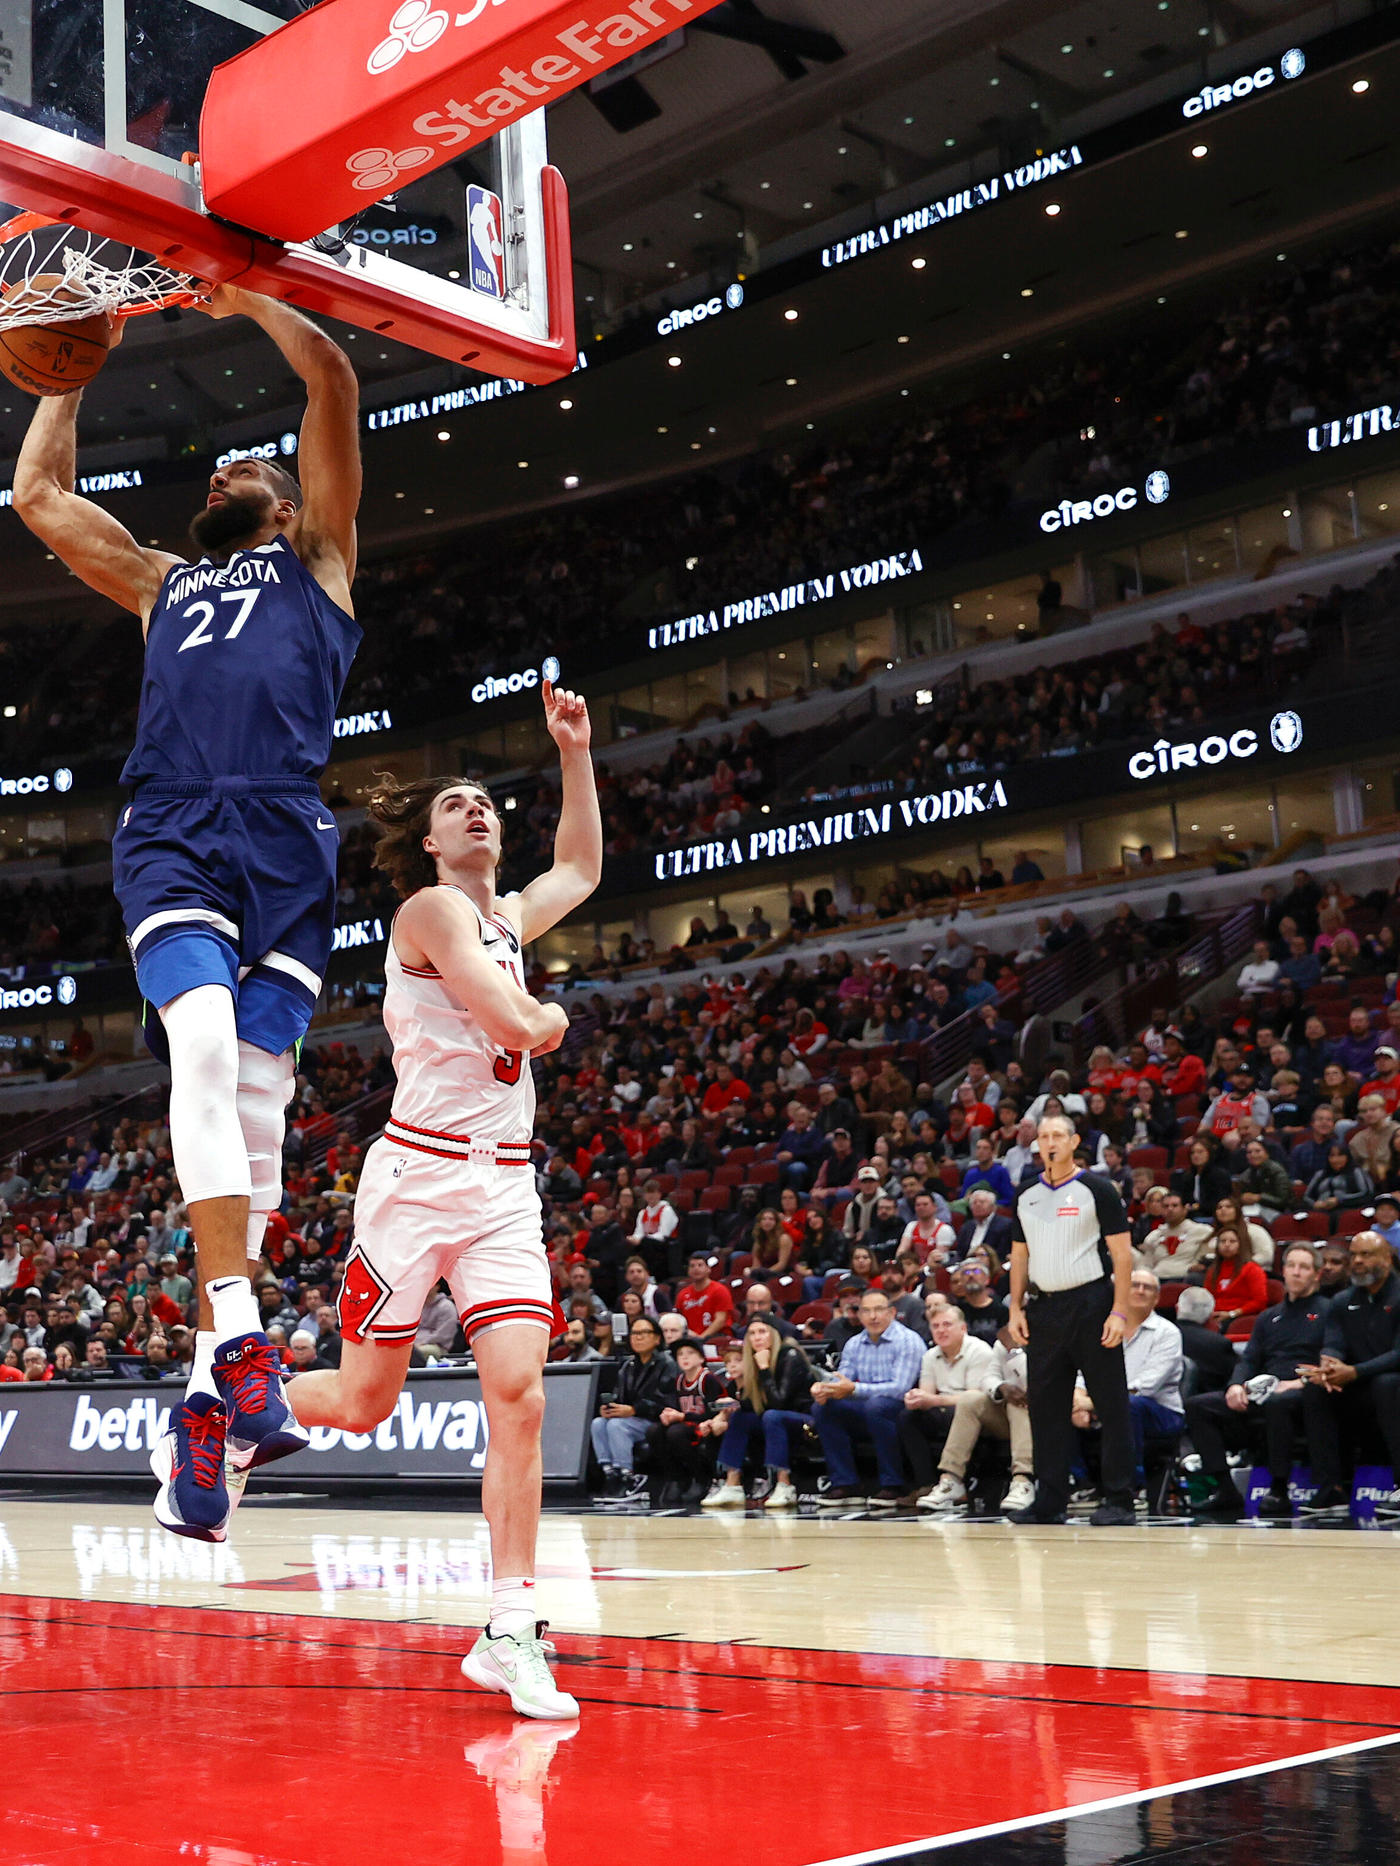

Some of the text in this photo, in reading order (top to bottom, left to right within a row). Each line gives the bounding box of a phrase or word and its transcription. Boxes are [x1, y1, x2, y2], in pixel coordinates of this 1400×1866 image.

[412, 0, 693, 147] StateFar
[1182, 66, 1276, 118] CÎROC
[821, 145, 1083, 268] ULTRA PREMIUM VODKA
[474, 268, 494, 291] NBA
[657, 297, 723, 336] CÎROC
[368, 400, 430, 430] ULTRA
[80, 469, 143, 493] VODKA
[1039, 487, 1138, 533] CÎROC
[165, 559, 282, 611] MINNESOTA
[648, 548, 923, 649] ULTRA PREMIUM VODKA
[177, 588, 262, 654] 27
[471, 668, 539, 703] CÎROC
[333, 709, 392, 738] ODKA
[1128, 729, 1259, 780] CÎROC
[655, 838, 743, 880] ULTRA
[749, 802, 892, 862] PREMIUM
[898, 777, 1008, 830] VODKA
